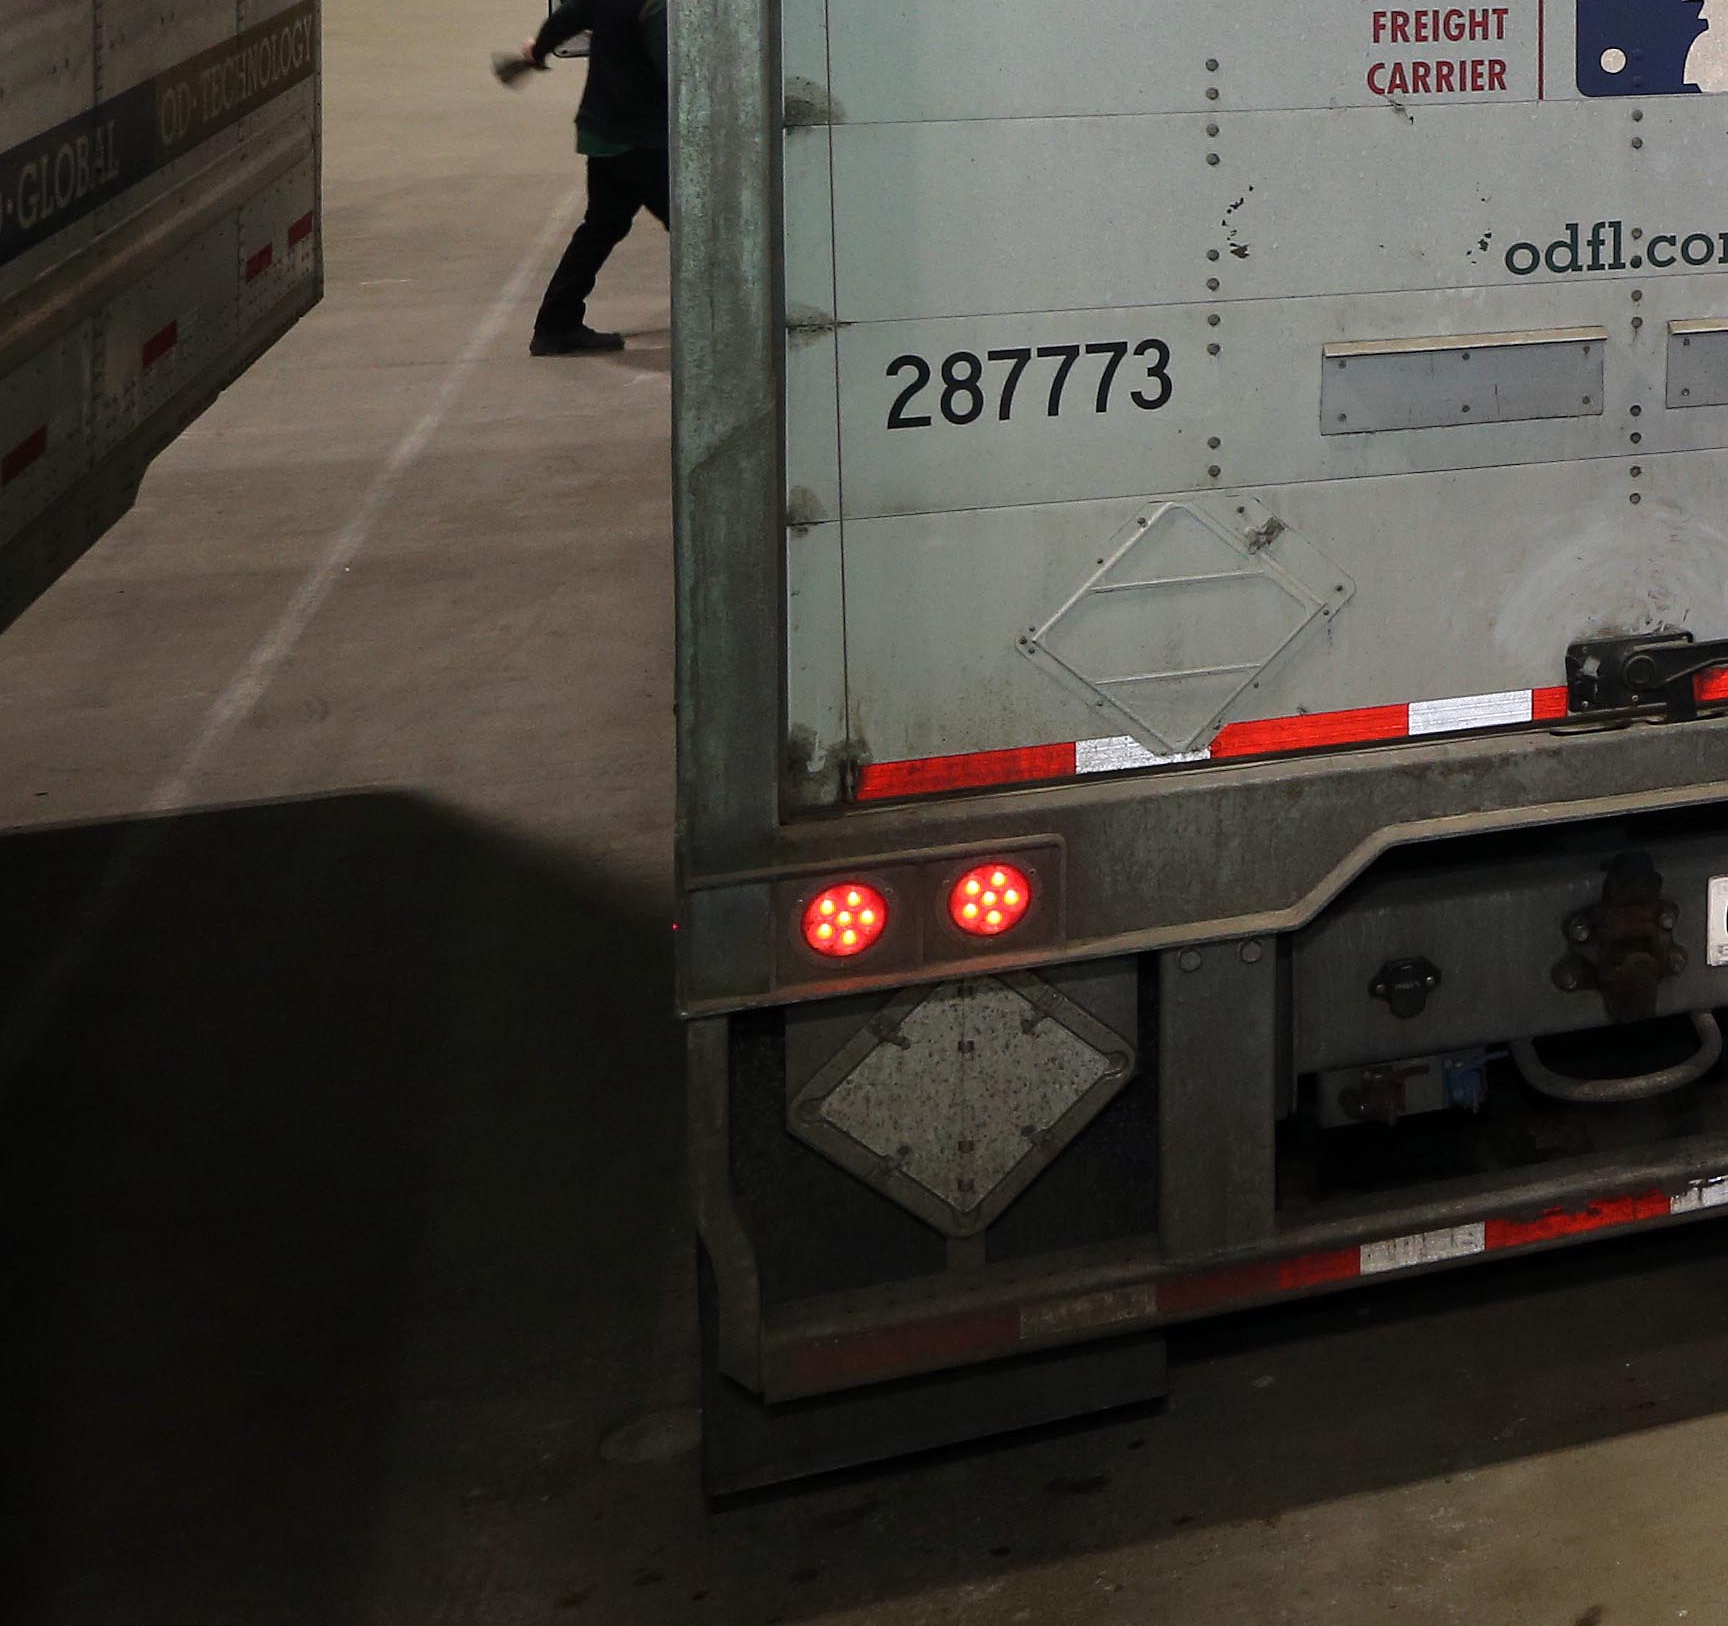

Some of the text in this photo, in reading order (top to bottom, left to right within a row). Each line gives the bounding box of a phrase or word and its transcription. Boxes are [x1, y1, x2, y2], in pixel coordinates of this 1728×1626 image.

[1372, 8, 1509, 44] FREIGHT
[1366, 59, 1508, 96] CARRIER
[886, 338, 1173, 430] 287773
